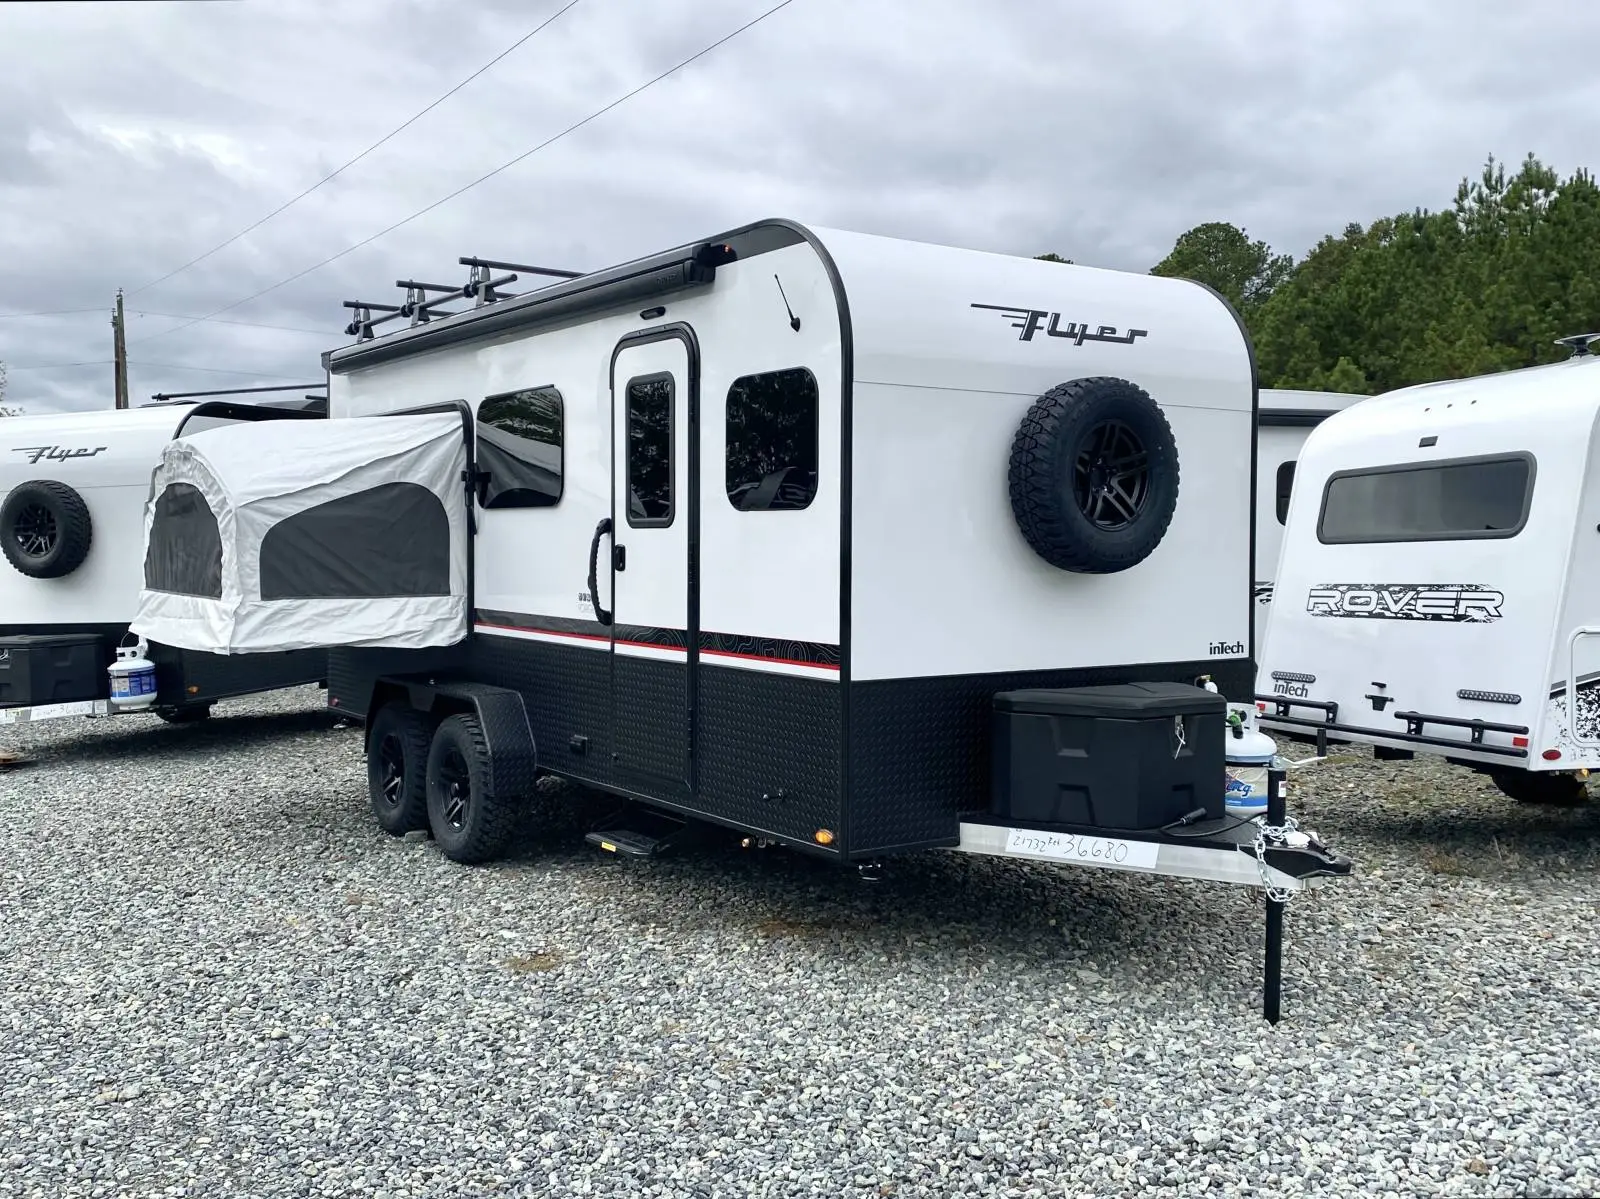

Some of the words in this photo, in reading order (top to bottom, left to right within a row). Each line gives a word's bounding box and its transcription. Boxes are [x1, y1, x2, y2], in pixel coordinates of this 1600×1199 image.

[970, 303, 1148, 346] Flyer
[11, 446, 107, 464] Flyer
[1306, 588, 1505, 618] ROVER
[1209, 641, 1244, 655] inTech
[1273, 680, 1308, 698] inTech
